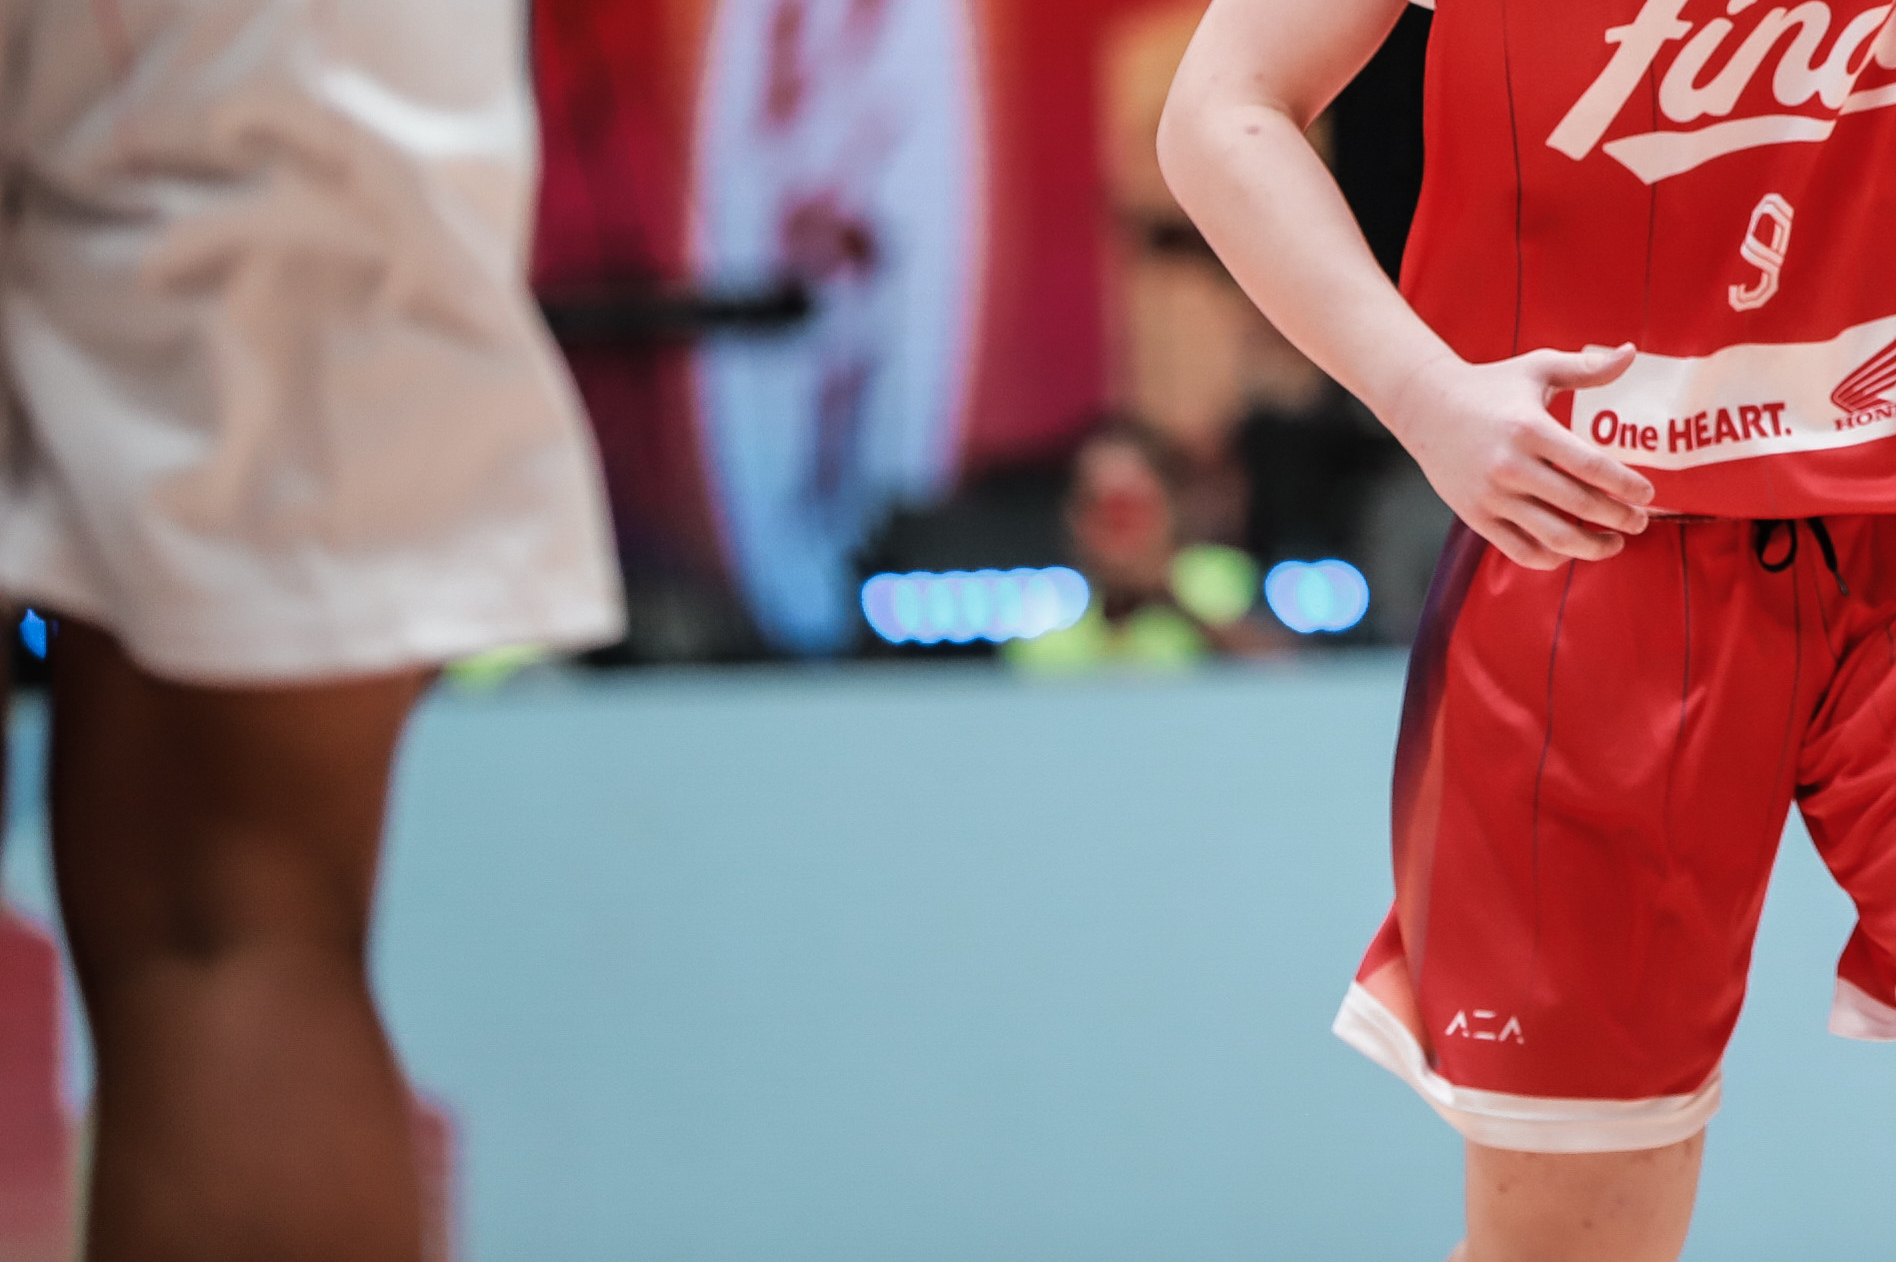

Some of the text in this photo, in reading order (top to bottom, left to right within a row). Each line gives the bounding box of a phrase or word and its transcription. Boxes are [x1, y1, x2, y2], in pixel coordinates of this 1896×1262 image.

[1728, 193, 1794, 312] 9
[1591, 402, 1792, 453] One HEART.
